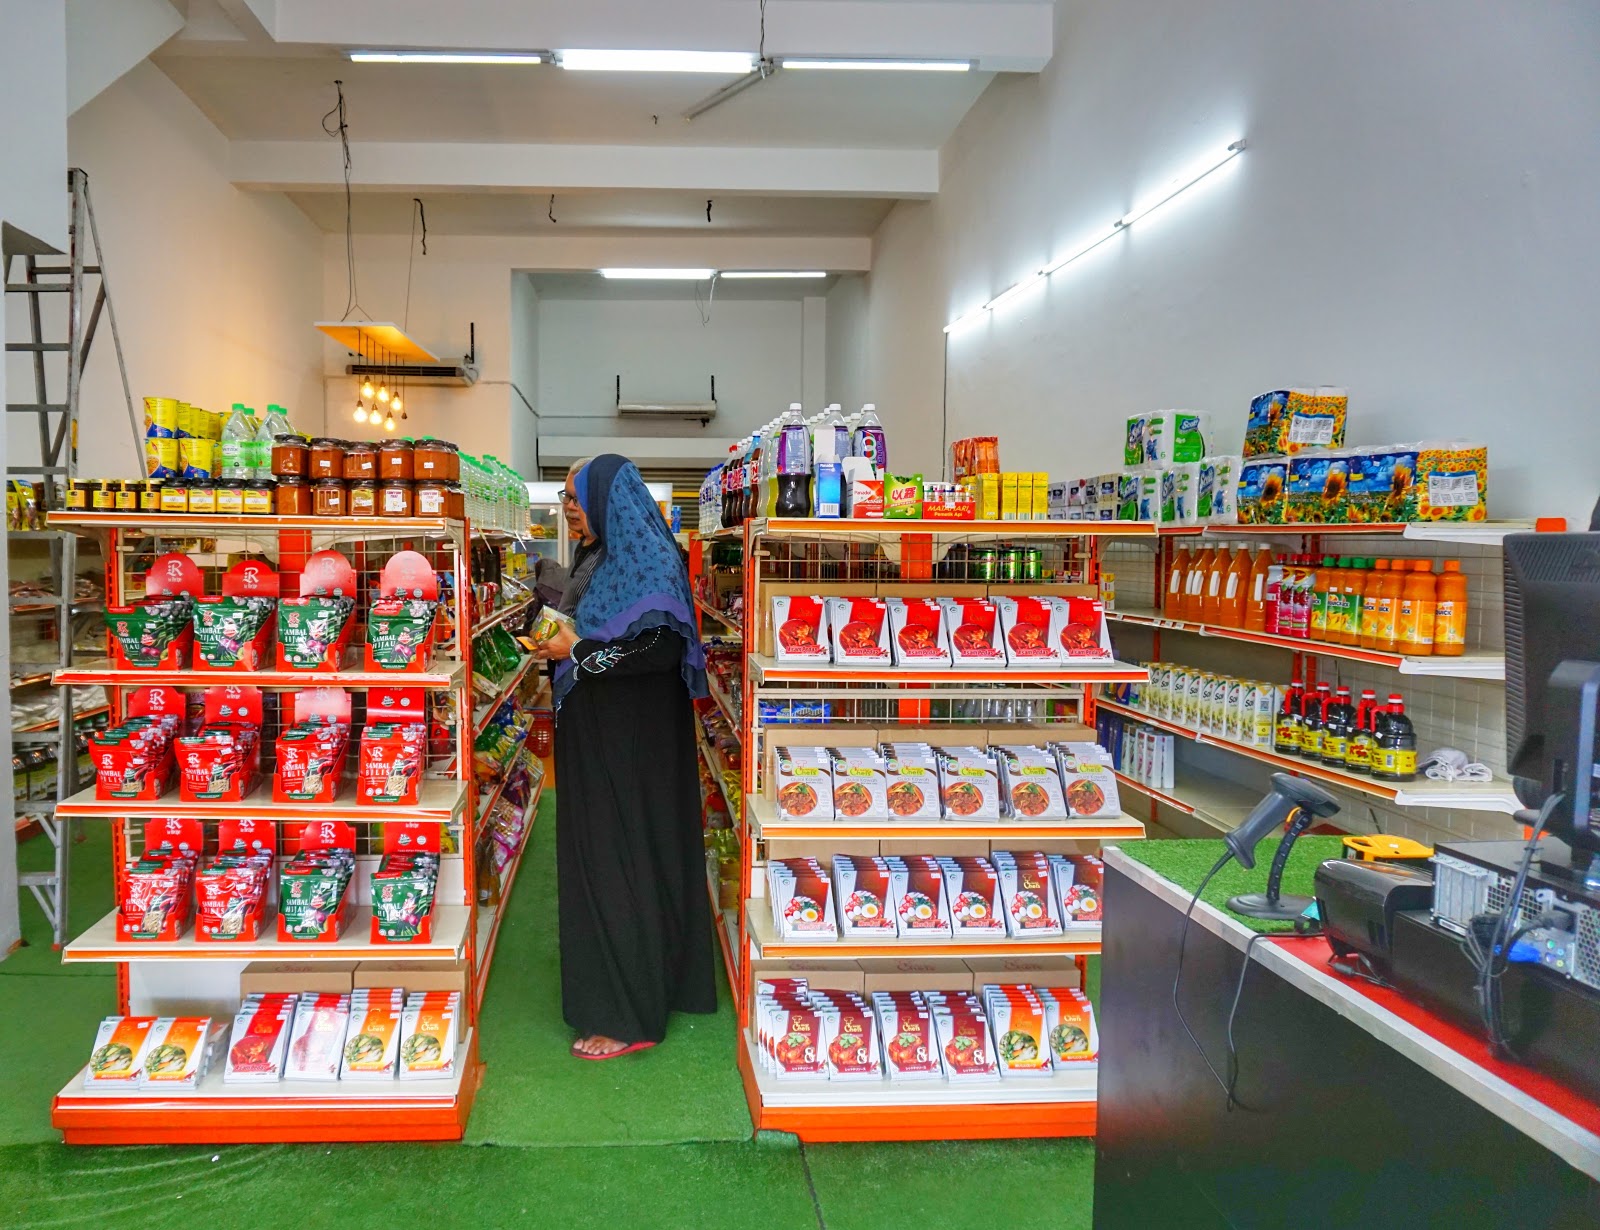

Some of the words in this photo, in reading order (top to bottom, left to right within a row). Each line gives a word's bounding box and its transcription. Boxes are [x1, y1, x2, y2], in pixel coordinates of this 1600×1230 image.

[372, 634, 396, 642] SAMBAL
[1023, 767, 1045, 775] Chefs
[1023, 881, 1041, 889] Chefs
[421, 1022, 439, 1031] Chefs
[792, 1023, 811, 1032] Chefs
[844, 1024, 863, 1032] Chefs
[902, 1023, 921, 1032] Chefs
